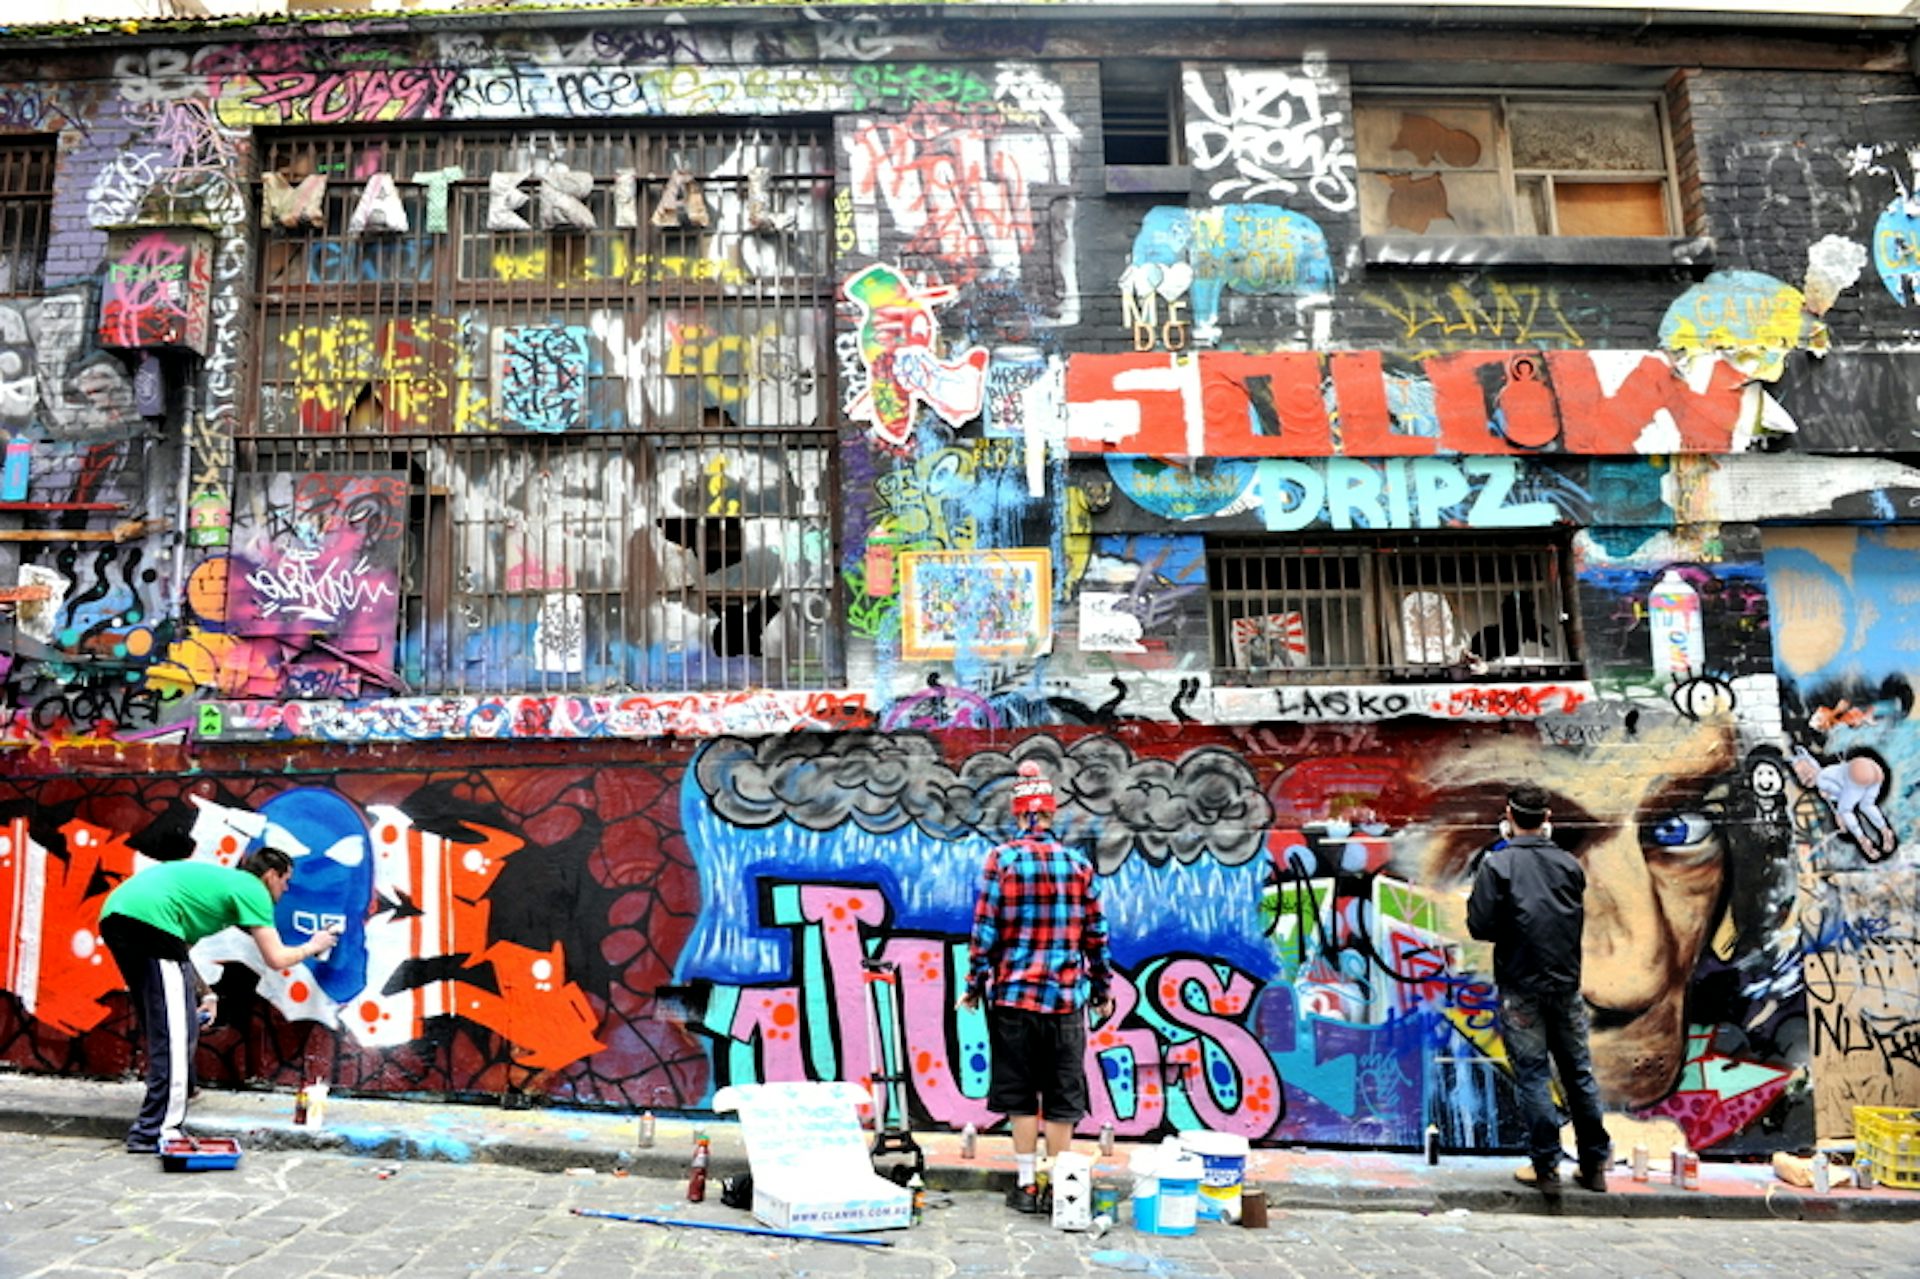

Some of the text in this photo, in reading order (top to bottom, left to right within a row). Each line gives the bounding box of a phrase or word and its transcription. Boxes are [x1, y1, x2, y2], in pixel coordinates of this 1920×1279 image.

[260, 166, 797, 236] MATERIAL
[1258, 457, 1561, 532] DRIPZ
[1275, 688, 1409, 717] LASKO
